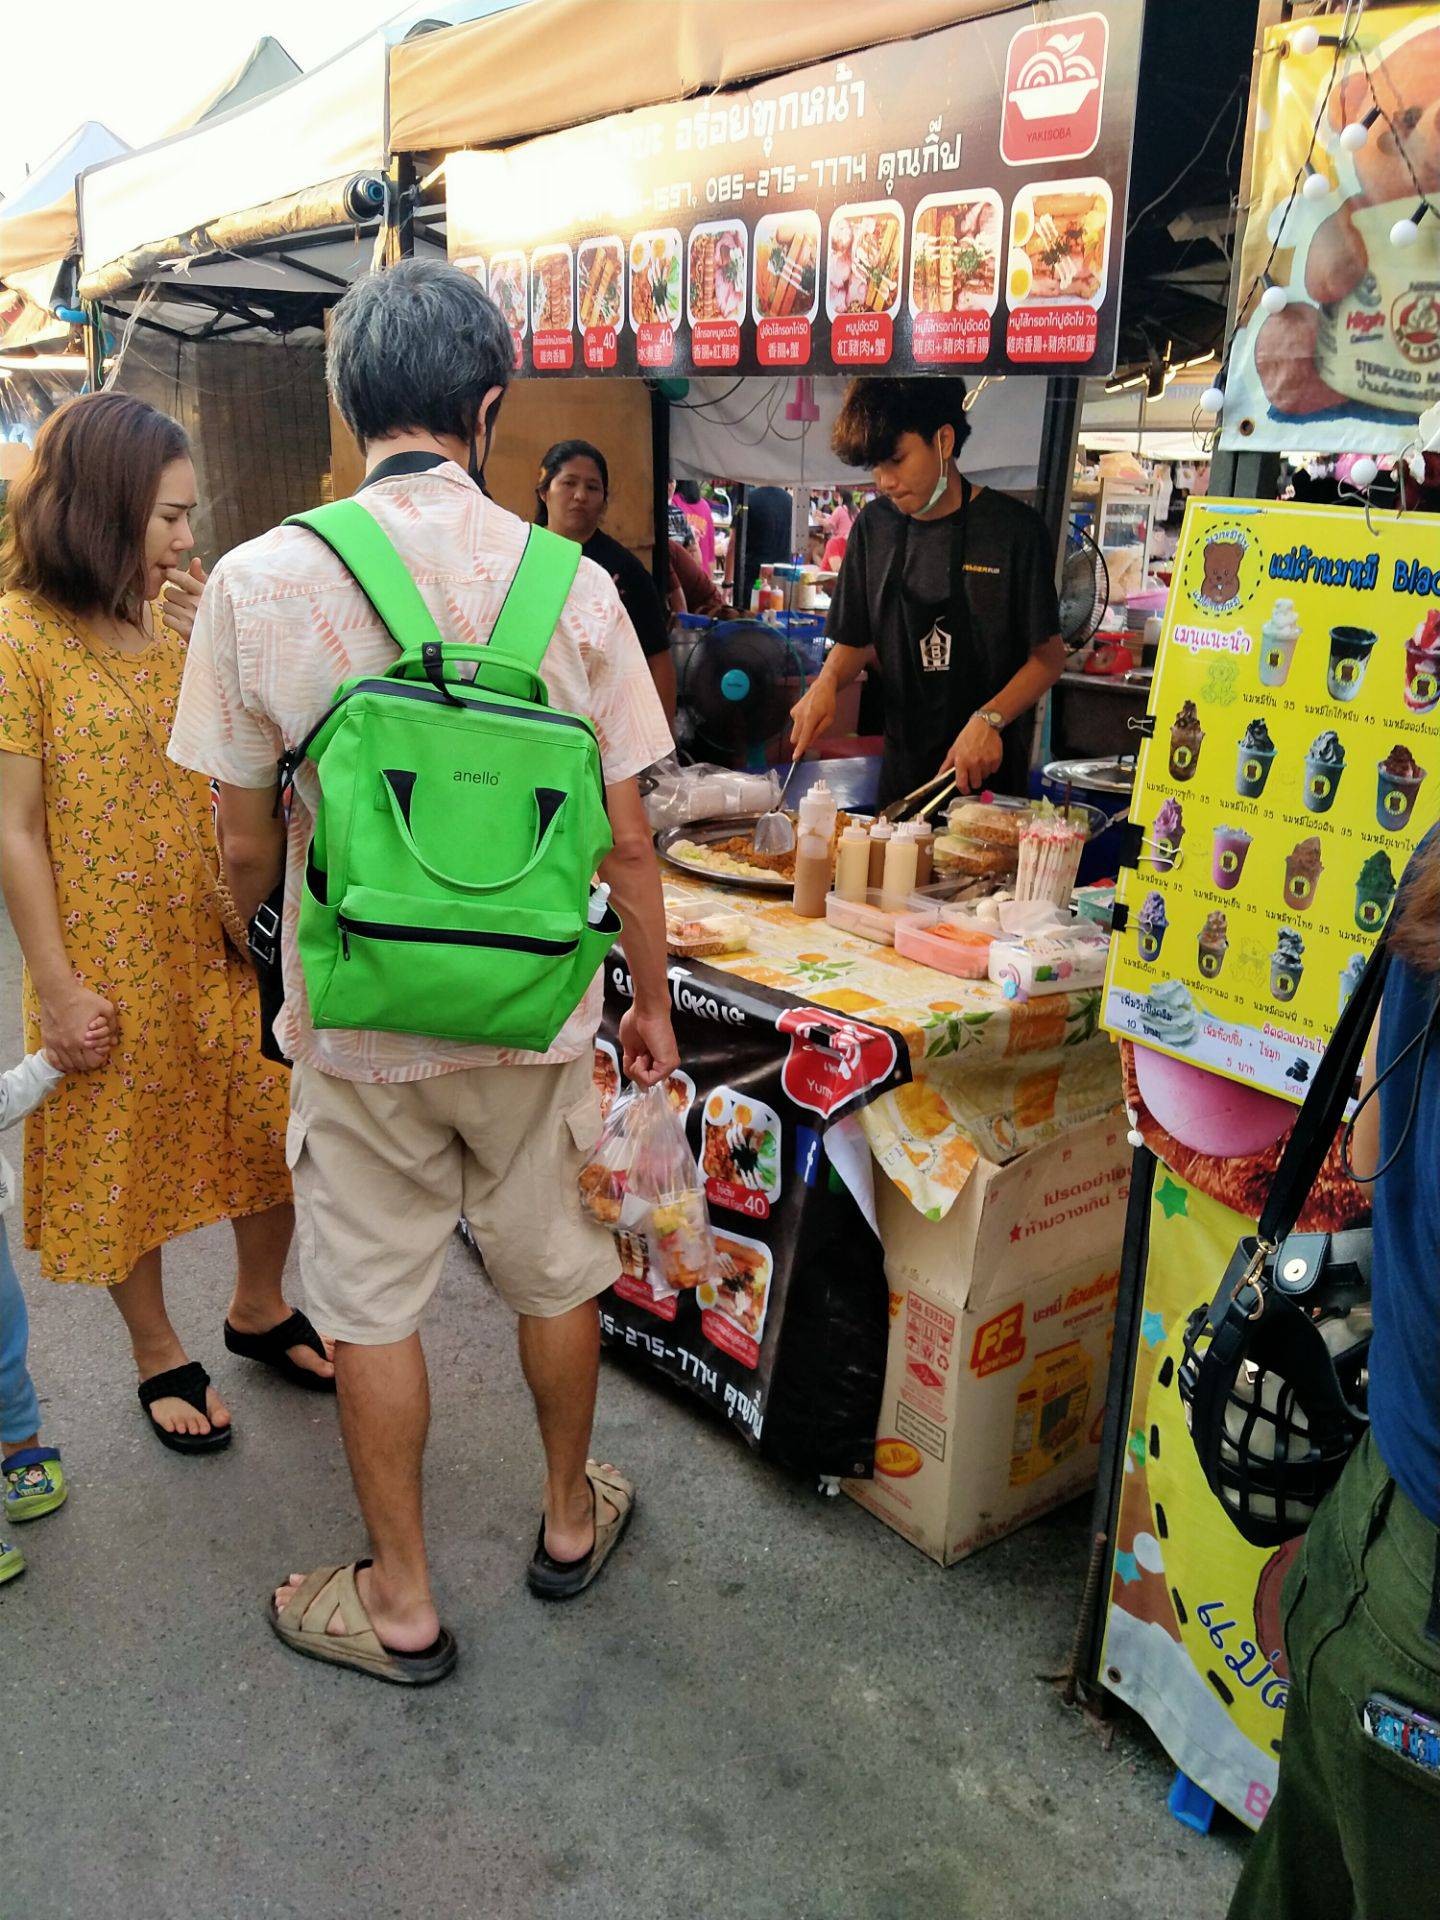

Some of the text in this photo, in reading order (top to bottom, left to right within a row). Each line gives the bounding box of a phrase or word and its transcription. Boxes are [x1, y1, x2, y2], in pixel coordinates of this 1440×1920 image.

[675, 62, 866, 157] อร่อยทุกหน้า
[1026, 128, 1072, 142] YAKISOBA
[1085, 314, 1097, 327] 70
[1346, 311, 1385, 333] High
[603, 332, 615, 350] 40
[659, 328, 673, 347] 40
[1174, 626, 1251, 653] เมนูแนะนำ
[453, 771, 499, 786] anello
[1127, 1019, 1137, 1029] 10
[744, 1195, 766, 1216] 40
[599, 1309, 718, 1394] 5-275-7774
